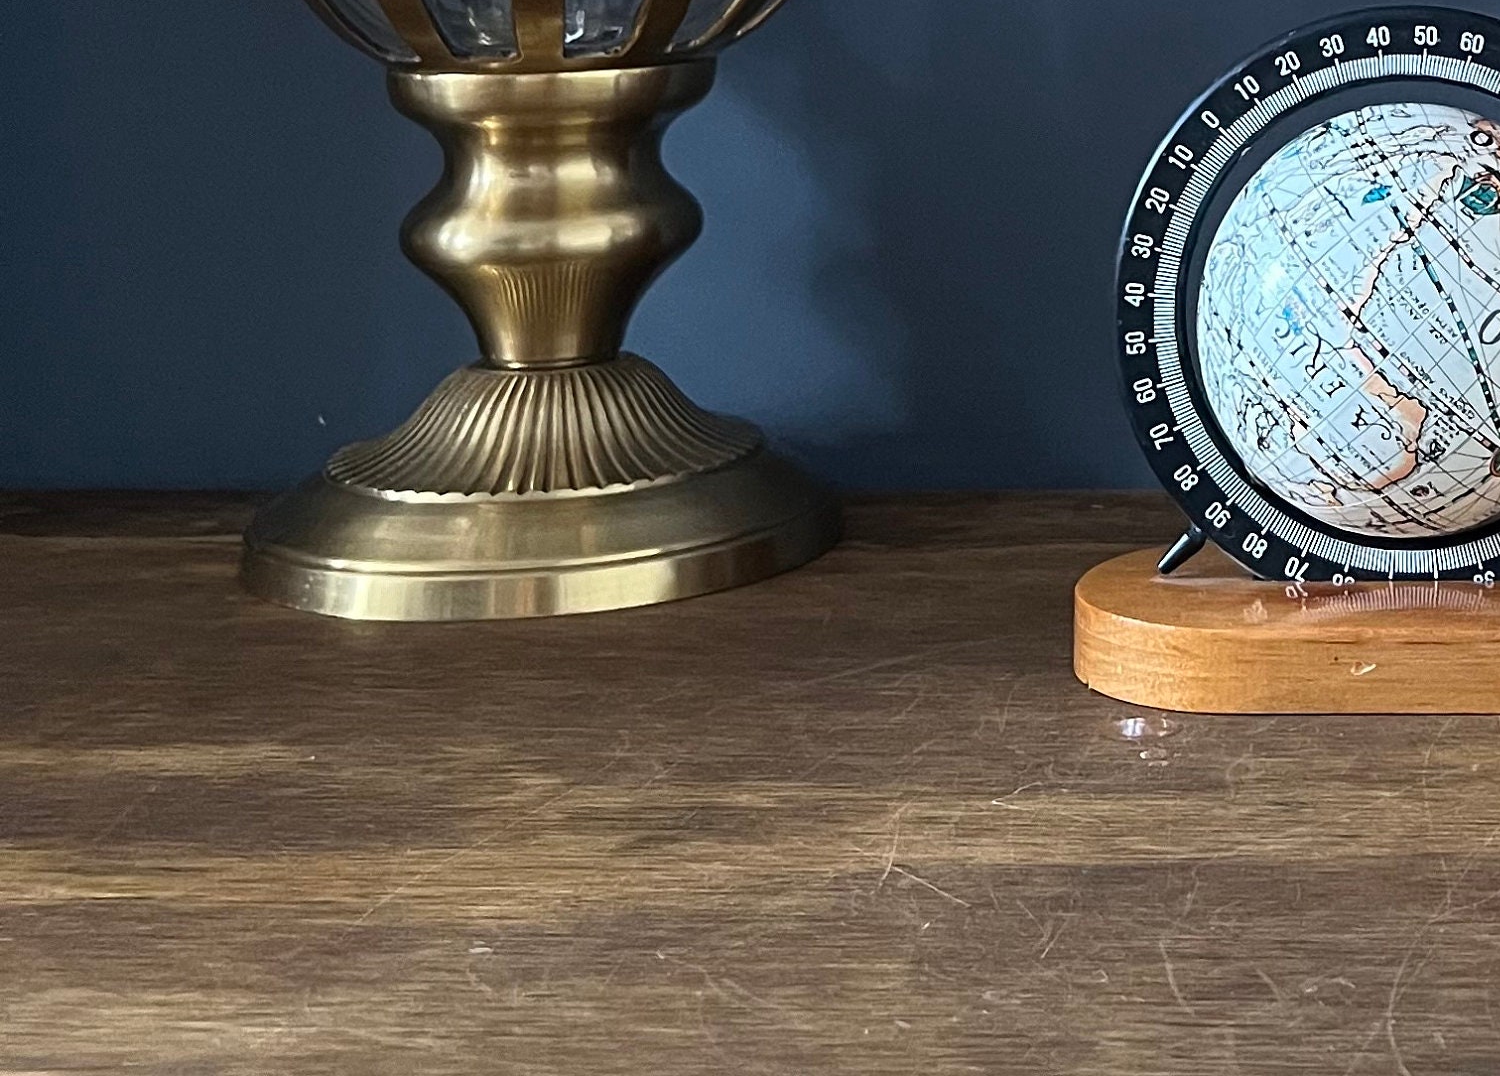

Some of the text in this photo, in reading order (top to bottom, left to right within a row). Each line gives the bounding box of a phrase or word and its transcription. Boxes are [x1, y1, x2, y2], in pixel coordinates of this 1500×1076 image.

[1320, 35, 1344, 57] 30
[1366, 26, 1390, 47] 40
[1414, 26, 1437, 45] 50
[1460, 32, 1484, 53] 60
[1275, 51, 1300, 76] 20
[1234, 76, 1259, 100] 10
[1201, 111, 1219, 128] 0
[1169, 145, 1193, 169] 10
[1145, 188, 1169, 214] 20
[1131, 234, 1153, 258] 30
[1124, 283, 1144, 307] 40
[1125, 332, 1146, 354] 50
[1133, 378, 1155, 403] 60
[1150, 424, 1173, 450] 70
[1174, 465, 1198, 490] 80
[1205, 502, 1231, 528] 90
[1242, 533, 1267, 558] 80
[1285, 556, 1309, 583] 70
